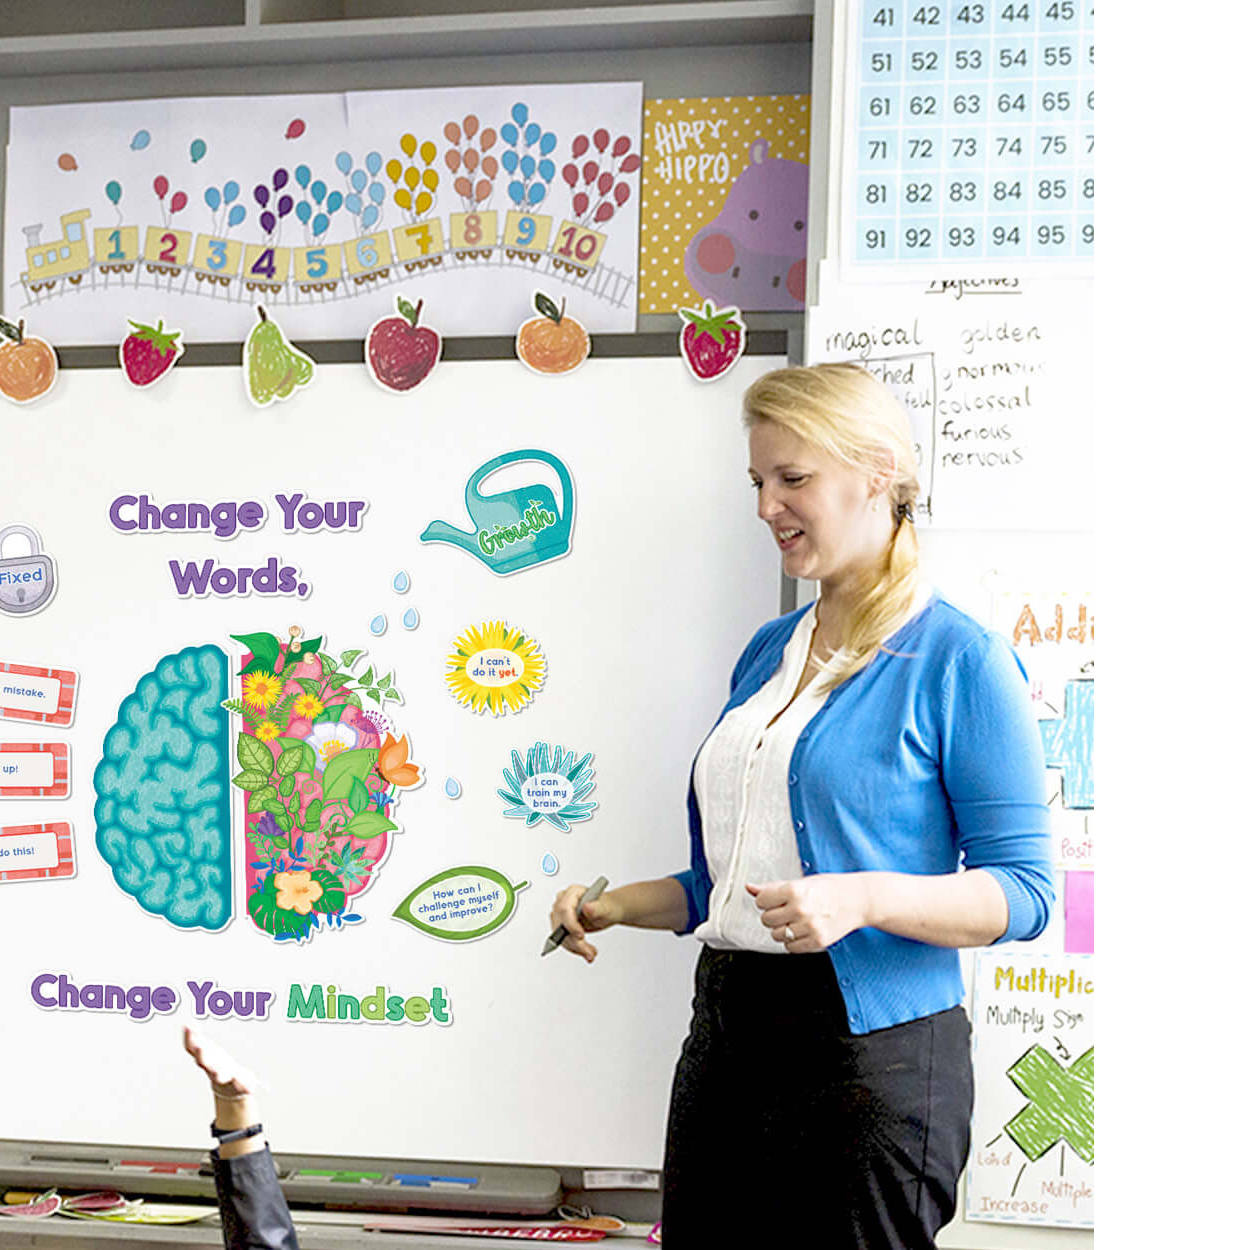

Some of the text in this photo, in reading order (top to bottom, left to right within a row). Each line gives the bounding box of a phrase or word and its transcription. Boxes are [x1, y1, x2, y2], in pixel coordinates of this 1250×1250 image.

[873, 2, 1074, 26] 41 42 43 44 45
[871, 53, 892, 72] 51
[911, 52, 938, 71] 52
[955, 50, 982, 69] 53
[999, 49, 1027, 68] 54
[1044, 47, 1072, 65] 55
[870, 98, 890, 116] 61
[909, 96, 936, 115] 62
[953, 95, 981, 113] 63
[997, 94, 1026, 112] 64
[1042, 92, 1070, 111] 65
[868, 141, 887, 159] 71
[908, 140, 933, 158] 72
[951, 138, 977, 157] 73
[996, 138, 1022, 155] 74
[1040, 136, 1067, 154] 75
[656, 152, 729, 183] HIPPO
[866, 184, 886, 204] 81
[905, 184, 933, 203] 82
[949, 182, 976, 201] 83
[993, 181, 1022, 200] 84
[1038, 180, 1066, 199] 85
[108, 214, 596, 278] 1 2 3 4 5 6 7 8 9 10
[865, 229, 886, 249] 91
[905, 228, 932, 247] 92
[948, 227, 975, 247] 93
[992, 226, 1021, 245] 94
[1037, 225, 1065, 245] 95
[826, 319, 1041, 361] magical golden
[941, 421, 1012, 442] furious
[109, 494, 365, 537] Change Your
[478, 500, 555, 555] Growth
[169, 557, 308, 596] Words,
[472, 667, 519, 678] do it yet.
[486, 656, 510, 666] can't
[4, 686, 46, 699] mistake.
[3, 765, 18, 775] up!
[527, 788, 567, 799] train my
[533, 798, 561, 808] brain.
[13, 847, 35, 856] this!
[418, 890, 500, 914] challenge myself
[432, 888, 454, 900] How
[457, 886, 475, 895] can
[429, 903, 493, 923] and improve?
[30, 973, 450, 1022] Change Your Mindset
[986, 1005, 1084, 1033] Multiply Sign
[980, 1197, 1048, 1214] Increase
